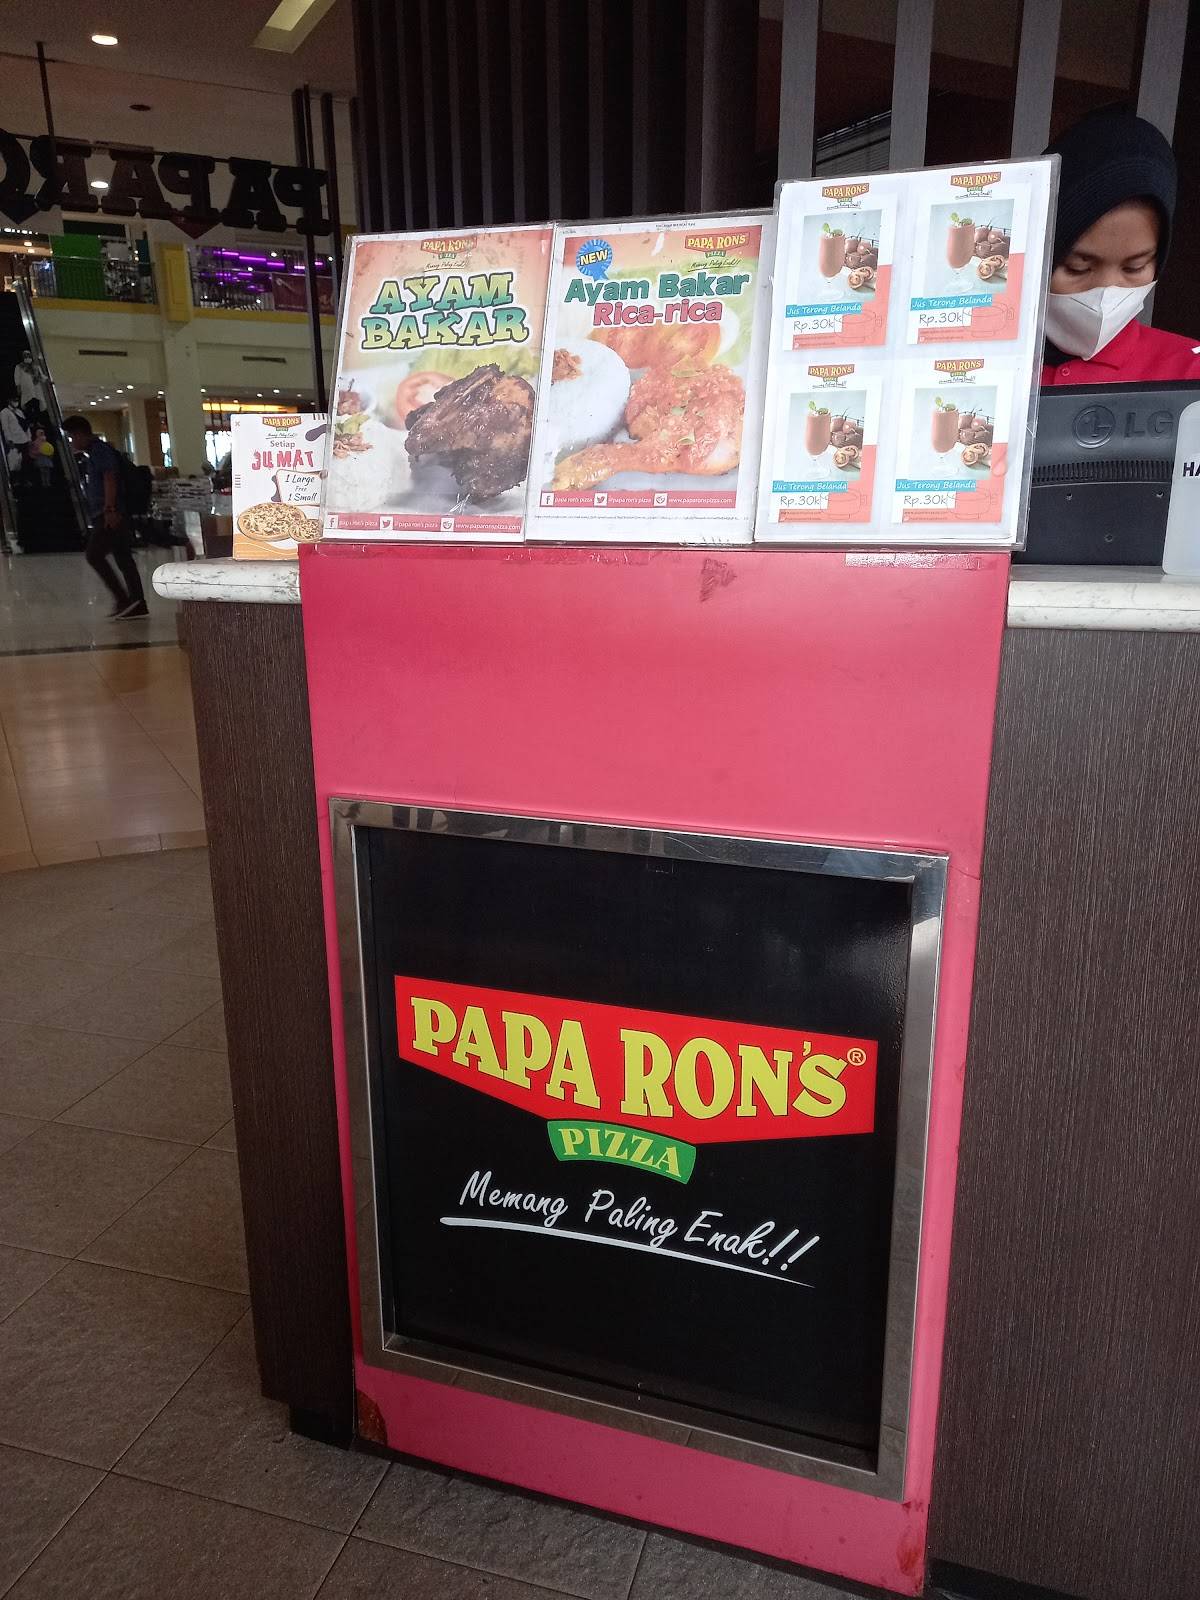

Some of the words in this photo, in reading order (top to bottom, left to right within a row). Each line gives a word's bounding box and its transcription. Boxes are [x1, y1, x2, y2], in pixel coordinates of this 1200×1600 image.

[687, 237, 714, 249] PAPA
[580, 249, 608, 267] NEW
[369, 271, 514, 315] AYAM
[564, 278, 650, 306] Ayam
[658, 271, 750, 299] Bakar
[787, 307, 800, 315] Jus
[802, 305, 828, 315] Terong
[831, 303, 862, 312] Belanda
[912, 300, 926, 308] Jus
[929, 298, 956, 307] Terong
[959, 295, 992, 305] Belanda
[592, 298, 723, 326] Rica-rica
[361, 306, 530, 350] BAKAR
[1123, 409, 1174, 438] LG
[270, 440, 296, 449] Setiap
[292, 474, 315, 486] Large
[789, 483, 815, 491] Terong
[817, 481, 847, 490] Belanda
[897, 481, 910, 489] Jus
[912, 481, 940, 490] Terong
[943, 480, 976, 489] Belanda
[293, 493, 318, 502] Small
[410, 996, 601, 1110] PAPA
[620, 1028, 849, 1120] RON'S
[557, 1126, 683, 1178] PIZZA
[459, 1169, 569, 1222] Memang
[584, 1189, 678, 1248] Paling
[683, 1210, 820, 1271] Enak!!
